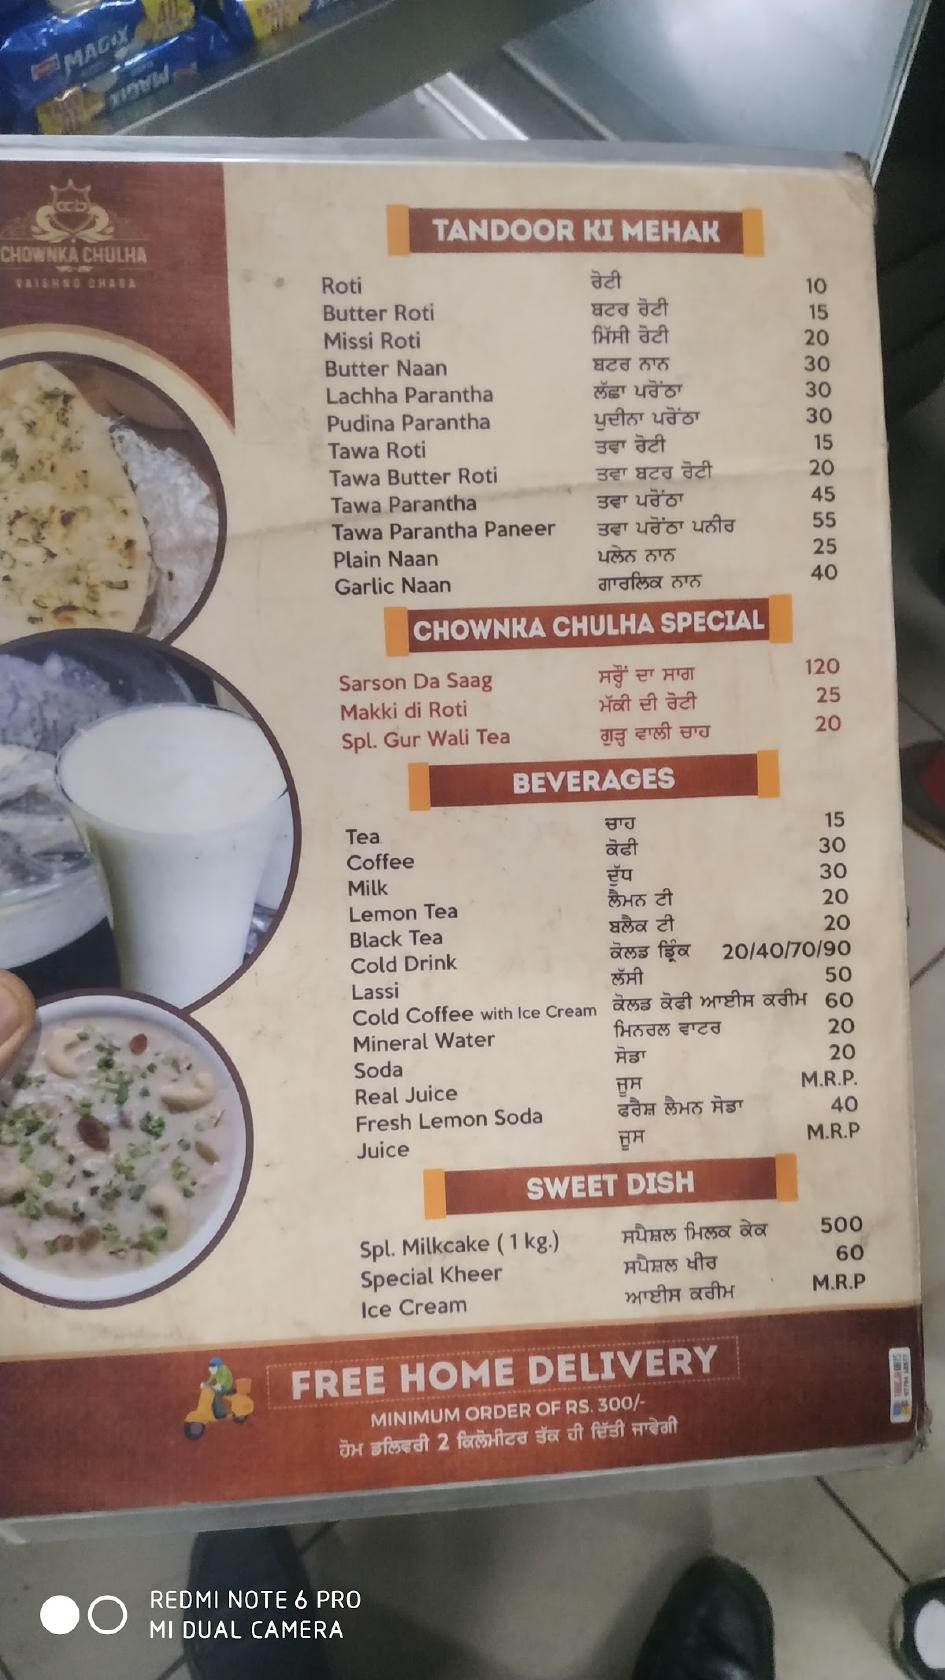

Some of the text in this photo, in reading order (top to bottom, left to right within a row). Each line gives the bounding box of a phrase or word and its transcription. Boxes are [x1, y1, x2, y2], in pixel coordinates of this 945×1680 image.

[432, 219, 720, 243] TANDOOR KI MEHAK
[0, 247, 147, 263] CHOWNKA CHULHA
[322, 277, 362, 294] Roti
[591, 270, 621, 289] ਰੋਟੀ
[806, 278, 827, 294] 10
[323, 304, 434, 321] Butter Roti
[592, 297, 668, 317] ਬਟਰ ਰੋਟੀ
[810, 304, 828, 320] 15
[325, 331, 420, 349] Missi Roti
[805, 330, 829, 346] 20
[325, 360, 447, 377] Butter Naan
[593, 357, 669, 372] ਬਟਰ ਨਾਨ
[805, 356, 830, 372] 30
[326, 385, 493, 404] Lachha Parantha
[806, 382, 831, 397] 30
[327, 413, 490, 432] Pudina Parantha
[806, 408, 831, 424] 30
[328, 441, 425, 459] Tawa Roti
[595, 434, 665, 454] ਤਵਾ ਰੋਟੀ
[814, 435, 833, 450] 15
[329, 467, 497, 486] Tawa Butter Roti
[810, 460, 834, 476] 20
[811, 486, 835, 502] 45
[331, 495, 476, 513] Tawa Parantha
[813, 512, 836, 528] 55
[332, 521, 555, 540] Tawa Parantha Paneer
[814, 538, 837, 554] 25
[334, 551, 438, 568] Plain Naan
[811, 565, 837, 580] 40
[335, 577, 451, 595] Garlic Naan
[414, 609, 765, 641] CHOWNKA CHULHA SPECIAL
[636, 667, 695, 682] ਦਾ ਸਾਗ
[806, 658, 840, 675] 120
[339, 672, 492, 692] Sarson Da Saag
[640, 691, 697, 711] ਦੀ ਰੋਟੀ
[817, 687, 841, 703] 25
[341, 701, 467, 721] Makki di Roti
[635, 721, 711, 740] ਵਾਲੀ ਚਾਹ
[816, 715, 841, 732] 20
[342, 729, 510, 753] Spl. Gur Wali Tea
[513, 767, 675, 794] BEVERAGES
[605, 817, 636, 830] ਚਾਹ
[825, 812, 845, 827] 15
[346, 829, 380, 845] Tea
[819, 837, 845, 853] 30
[347, 853, 414, 870] Coffee
[820, 863, 847, 880] 30
[348, 880, 388, 896] Milk
[823, 889, 848, 905] 20
[350, 904, 458, 922] Lemon Tea
[609, 914, 674, 933] ਬਲੈਕ ਟੀ
[824, 915, 850, 931] 20
[350, 930, 442, 948] Black Tea
[723, 940, 851, 960] 20/40/70/90
[351, 954, 457, 974] Cold Drink
[826, 966, 851, 983] 50
[352, 982, 399, 1000] Lassi
[825, 992, 853, 1008] 60
[353, 1005, 597, 1026] Cold Coffee with Ice Cream
[828, 1018, 854, 1034] 20
[353, 1032, 495, 1052] Mineral Water
[615, 1046, 646, 1064] ਸੋਡਾ
[829, 1044, 855, 1060] 20
[355, 1061, 403, 1079] Soda
[801, 1070, 857, 1088] M.R.P.
[355, 1085, 458, 1105] Real Juice
[831, 1096, 858, 1112] 40
[356, 1108, 543, 1132] Fresh Lemon Soda
[807, 1122, 860, 1140] M.R.P
[357, 1142, 409, 1159] Juice
[527, 1171, 694, 1200] SWEET DISH
[821, 1216, 862, 1234] 500
[361, 1240, 395, 1262] Spl.
[403, 1235, 489, 1256] Milkcake
[836, 1245, 864, 1261] 60
[687, 1251, 717, 1271] ਖੀਰ
[361, 1265, 502, 1292] Special Kheer
[813, 1274, 865, 1291] M.R.P
[690, 1281, 735, 1301] ਕਰੀਮ
[362, 1299, 467, 1319] Ice Cream
[292, 1345, 718, 1400] FREE HOME DELIVERY
[371, 1394, 645, 1427] MINIMUM ORDER OF RS. 300/-
[438, 1434, 449, 1451] 2
